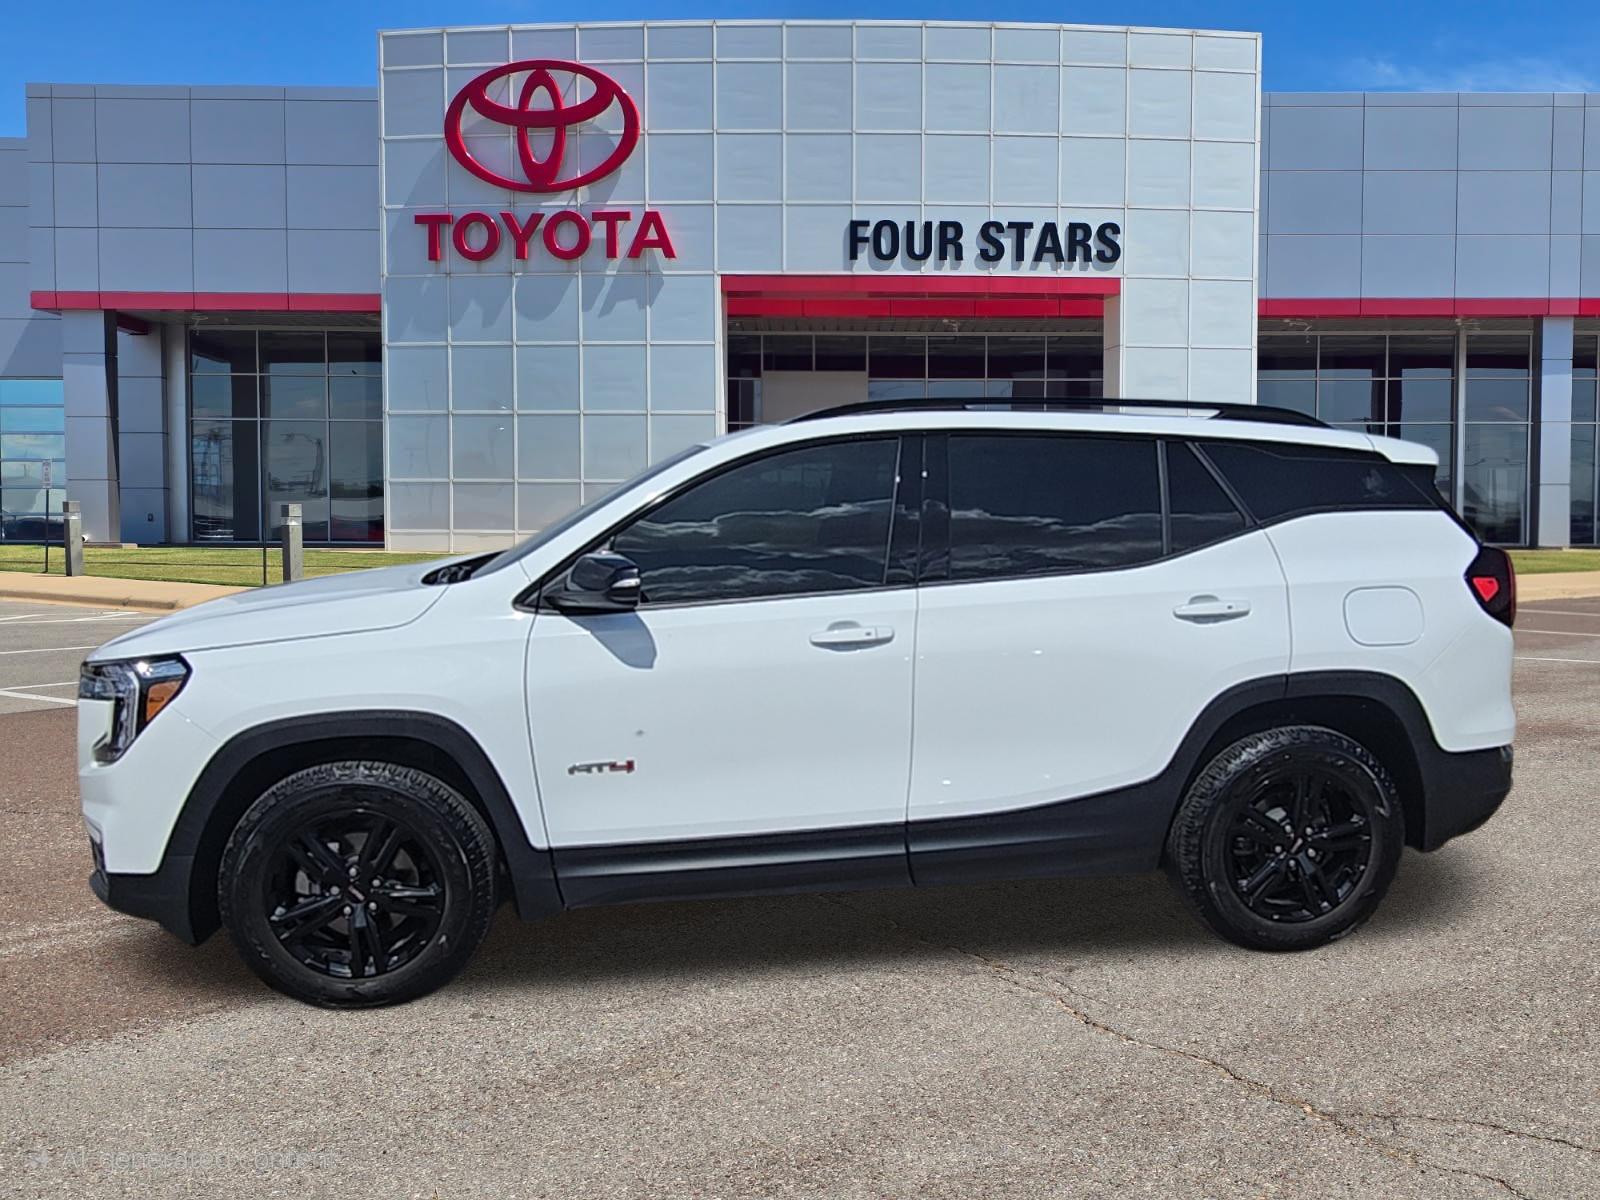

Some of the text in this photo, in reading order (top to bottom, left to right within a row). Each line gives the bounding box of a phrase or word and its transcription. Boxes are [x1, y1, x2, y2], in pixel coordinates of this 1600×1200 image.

[414, 210, 677, 261] TOYOTA
[849, 219, 1121, 264] FOUR STARS
